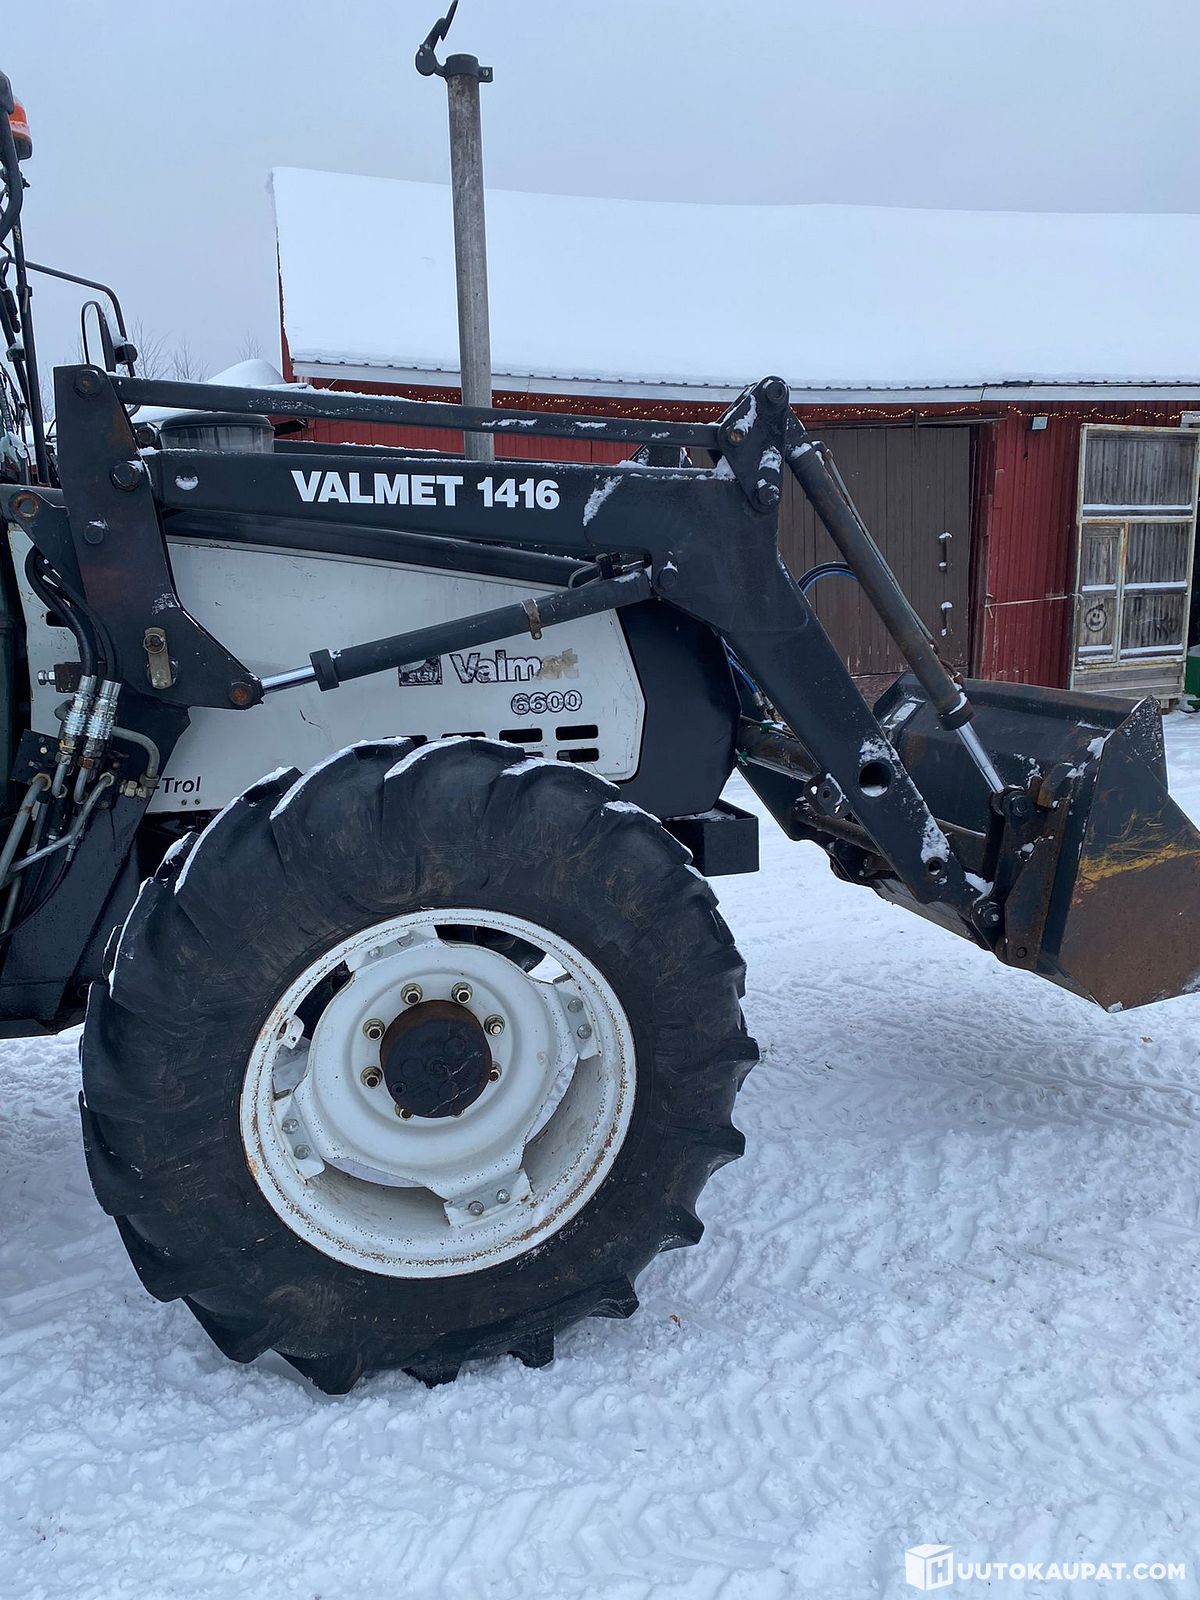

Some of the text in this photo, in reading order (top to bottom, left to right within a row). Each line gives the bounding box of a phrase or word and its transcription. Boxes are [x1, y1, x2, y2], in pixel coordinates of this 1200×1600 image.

[291, 470, 560, 510] VALMET 1416
[511, 690, 583, 715] 6600
